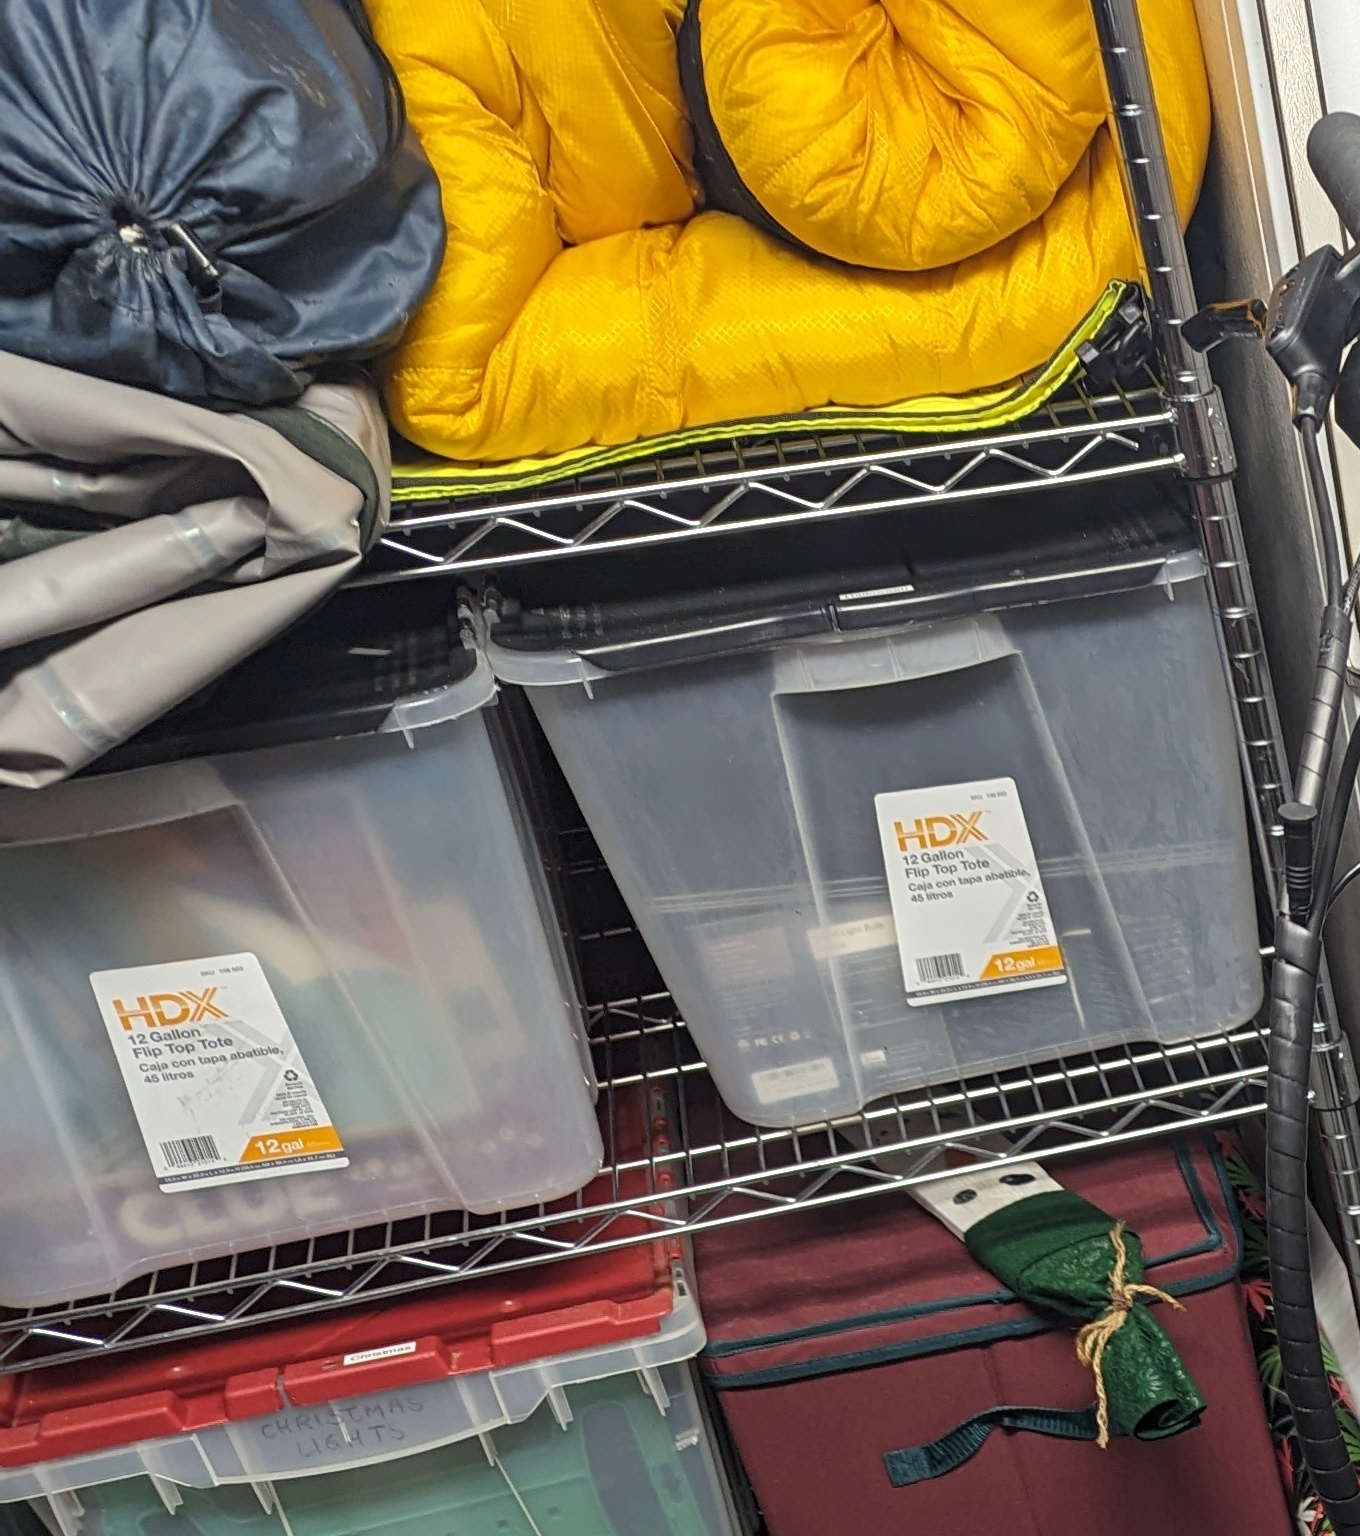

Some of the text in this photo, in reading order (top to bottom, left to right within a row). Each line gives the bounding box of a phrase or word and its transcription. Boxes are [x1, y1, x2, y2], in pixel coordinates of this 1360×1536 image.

[894, 811, 989, 852] HDX
[903, 850, 965, 866] 12 Gallon
[905, 859, 990, 879] Flip Top Tote
[908, 881, 934, 894] Caja
[937, 878, 956, 889] con
[958, 874, 983, 888] tapa
[910, 891, 954, 903] 45 litros
[112, 987, 229, 1031] HDX
[128, 1028, 201, 1046] 12 Gallon
[132, 1036, 233, 1059] Flip Top Tote
[139, 1045, 285, 1074] Caja con tapa abatible,
[143, 1069, 195, 1084] 45 litros
[120, 1182, 342, 1246] CLUE
[350, 1345, 411, 1362] Christmas
[261, 1396, 424, 1440] CHRISTMAS
[297, 1424, 405, 1458] LIGHTS
